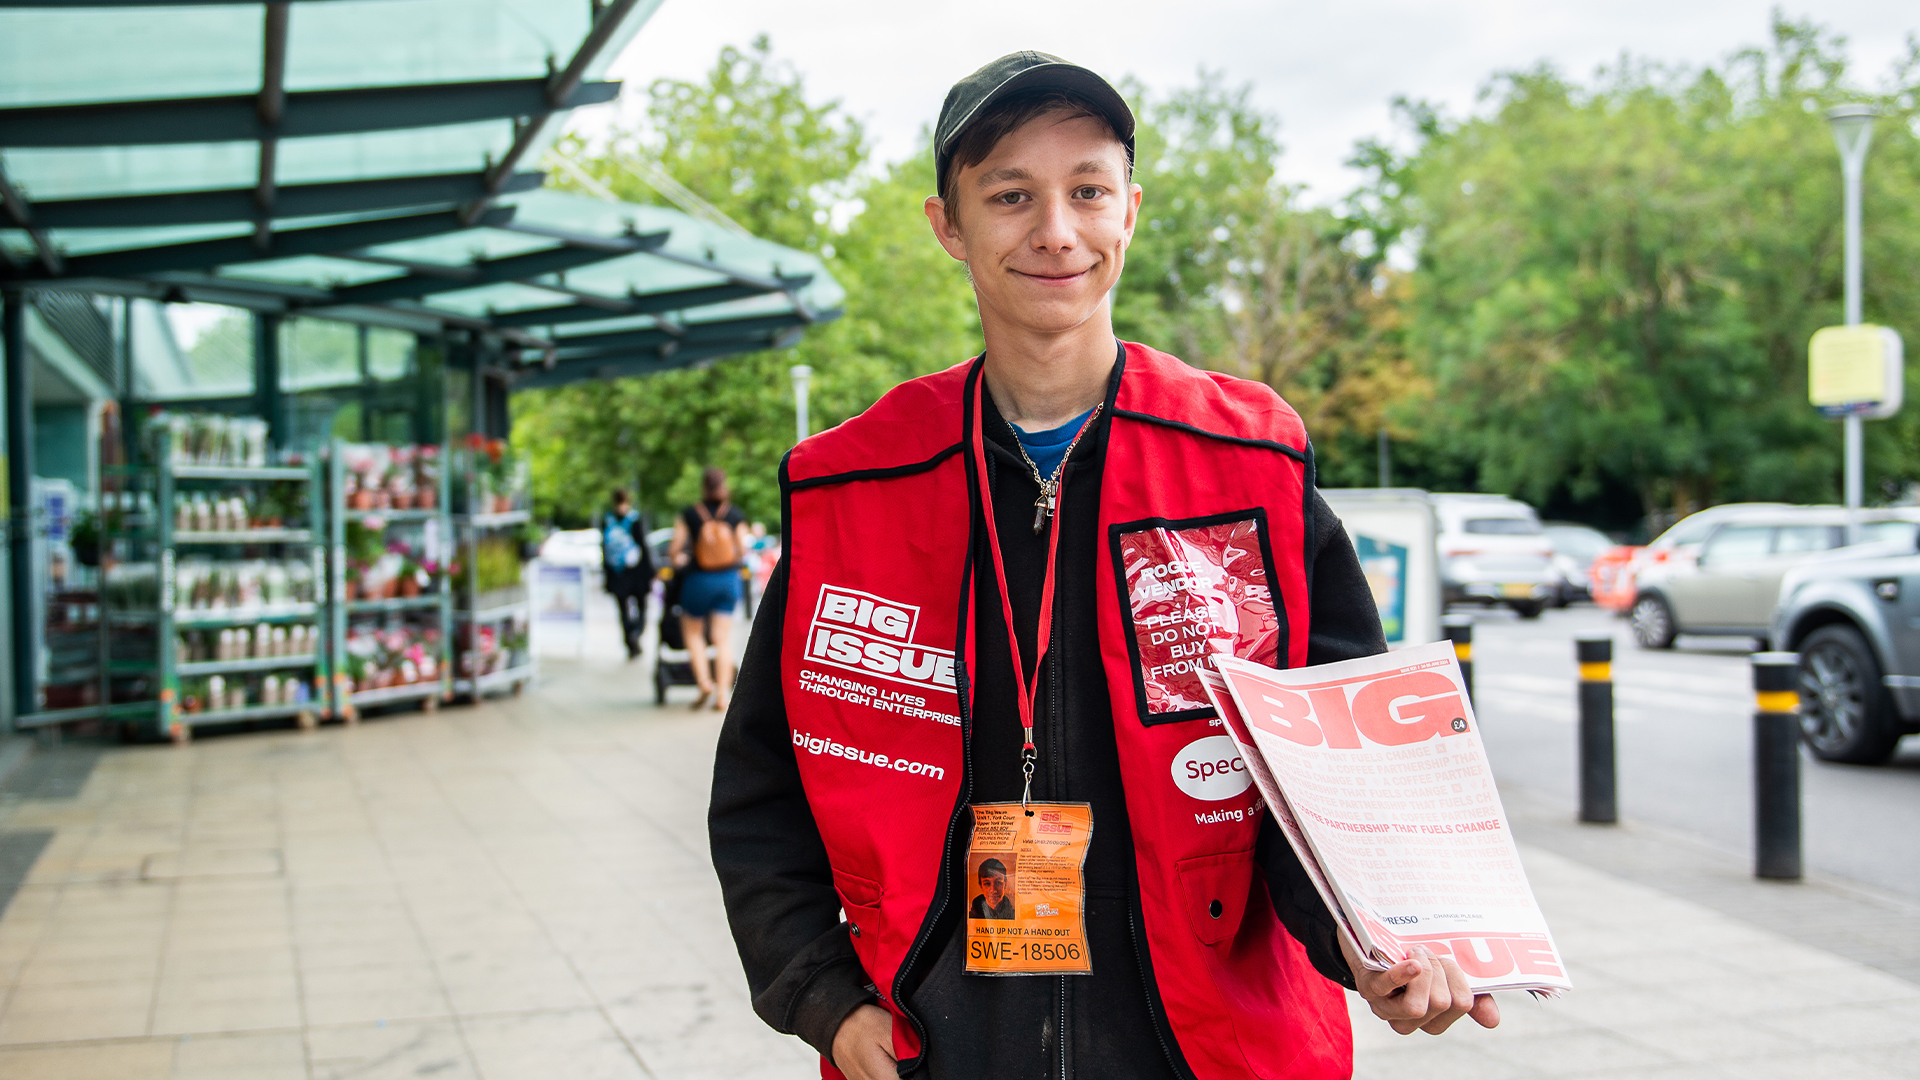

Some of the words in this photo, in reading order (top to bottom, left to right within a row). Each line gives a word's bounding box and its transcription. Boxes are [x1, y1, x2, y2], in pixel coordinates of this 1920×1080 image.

[1141, 561, 1203, 581] ROGUE
[1137, 577, 1214, 599] VENDOR
[821, 592, 910, 638] BIG
[1146, 605, 1219, 630] PLEASE
[1151, 630, 1179, 645] DO
[1182, 621, 1219, 640] NOT
[812, 628, 957, 687] ISSUE
[1170, 640, 1207, 659] BUY
[1150, 657, 1204, 680] FROM
[800, 669, 877, 696] CHANGING
[880, 689, 926, 707] LIVES
[799, 679, 870, 706] THROUGH
[872, 700, 962, 727] ENTERPRISE
[1228, 671, 1471, 749] BIG
[1209, 719, 1222, 727] sp
[792, 729, 945, 780] bigissue.com
[1322, 752, 1347, 762] THAT
[1350, 752, 1384, 762] FUELS
[1386, 746, 1431, 761] CHANGE
[1467, 738, 1475, 748] A
[1185, 757, 1247, 781] Spec
[1327, 764, 1335, 773] A
[1336, 765, 1375, 774] COFFEE
[1377, 756, 1450, 774] PARTNERSHIP
[1313, 772, 1353, 786] CHANGE
[1383, 777, 1391, 787] A
[1392, 774, 1433, 785] COFFEE
[1341, 787, 1366, 798] THAT
[1370, 788, 1402, 799] FUELS
[1404, 785, 1448, 798] CHANGE
[1339, 799, 1406, 810] PARTNERSHIP
[1409, 800, 1435, 810] THAT
[1439, 795, 1473, 808] FUELS
[1042, 813, 1060, 821] BIG
[1194, 809, 1244, 824] Making
[1247, 806, 1254, 816] a
[1322, 807, 1362, 820] CHANGE
[1391, 812, 1399, 821] A
[1400, 813, 1437, 822] COFFEE
[1039, 823, 1071, 833] ISSUE
[1324, 817, 1390, 833] PARTNERSHIP
[1392, 823, 1418, 834] THAT
[1420, 823, 1453, 834] FUELS
[1455, 819, 1501, 833] CHANGE
[1337, 832, 1376, 845] COFFEE
[1377, 835, 1444, 846] PARTNERSHIP
[1447, 836, 1473, 846] THAT
[1334, 841, 1373, 857] CHANGE
[1404, 847, 1412, 856] A
[1413, 847, 1451, 858] COFFEE
[1360, 859, 1393, 869] FUELS
[1395, 859, 1438, 869] CHANGE
[1361, 871, 1388, 881] THAT
[1391, 871, 1425, 881] FUELS
[1426, 871, 1468, 882] CHANGE
[1378, 884, 1386, 893] A
[1387, 883, 1429, 893] COFFEE
[1431, 883, 1497, 895] PARTNERSHIP
[1411, 895, 1439, 905] THAT
[1440, 896, 1473, 905] FUELS
[996, 927, 1006, 935] UP
[1023, 928, 1029, 936] A
[1031, 928, 1053, 936] HAND
[970, 941, 1080, 961] SWE-18506
